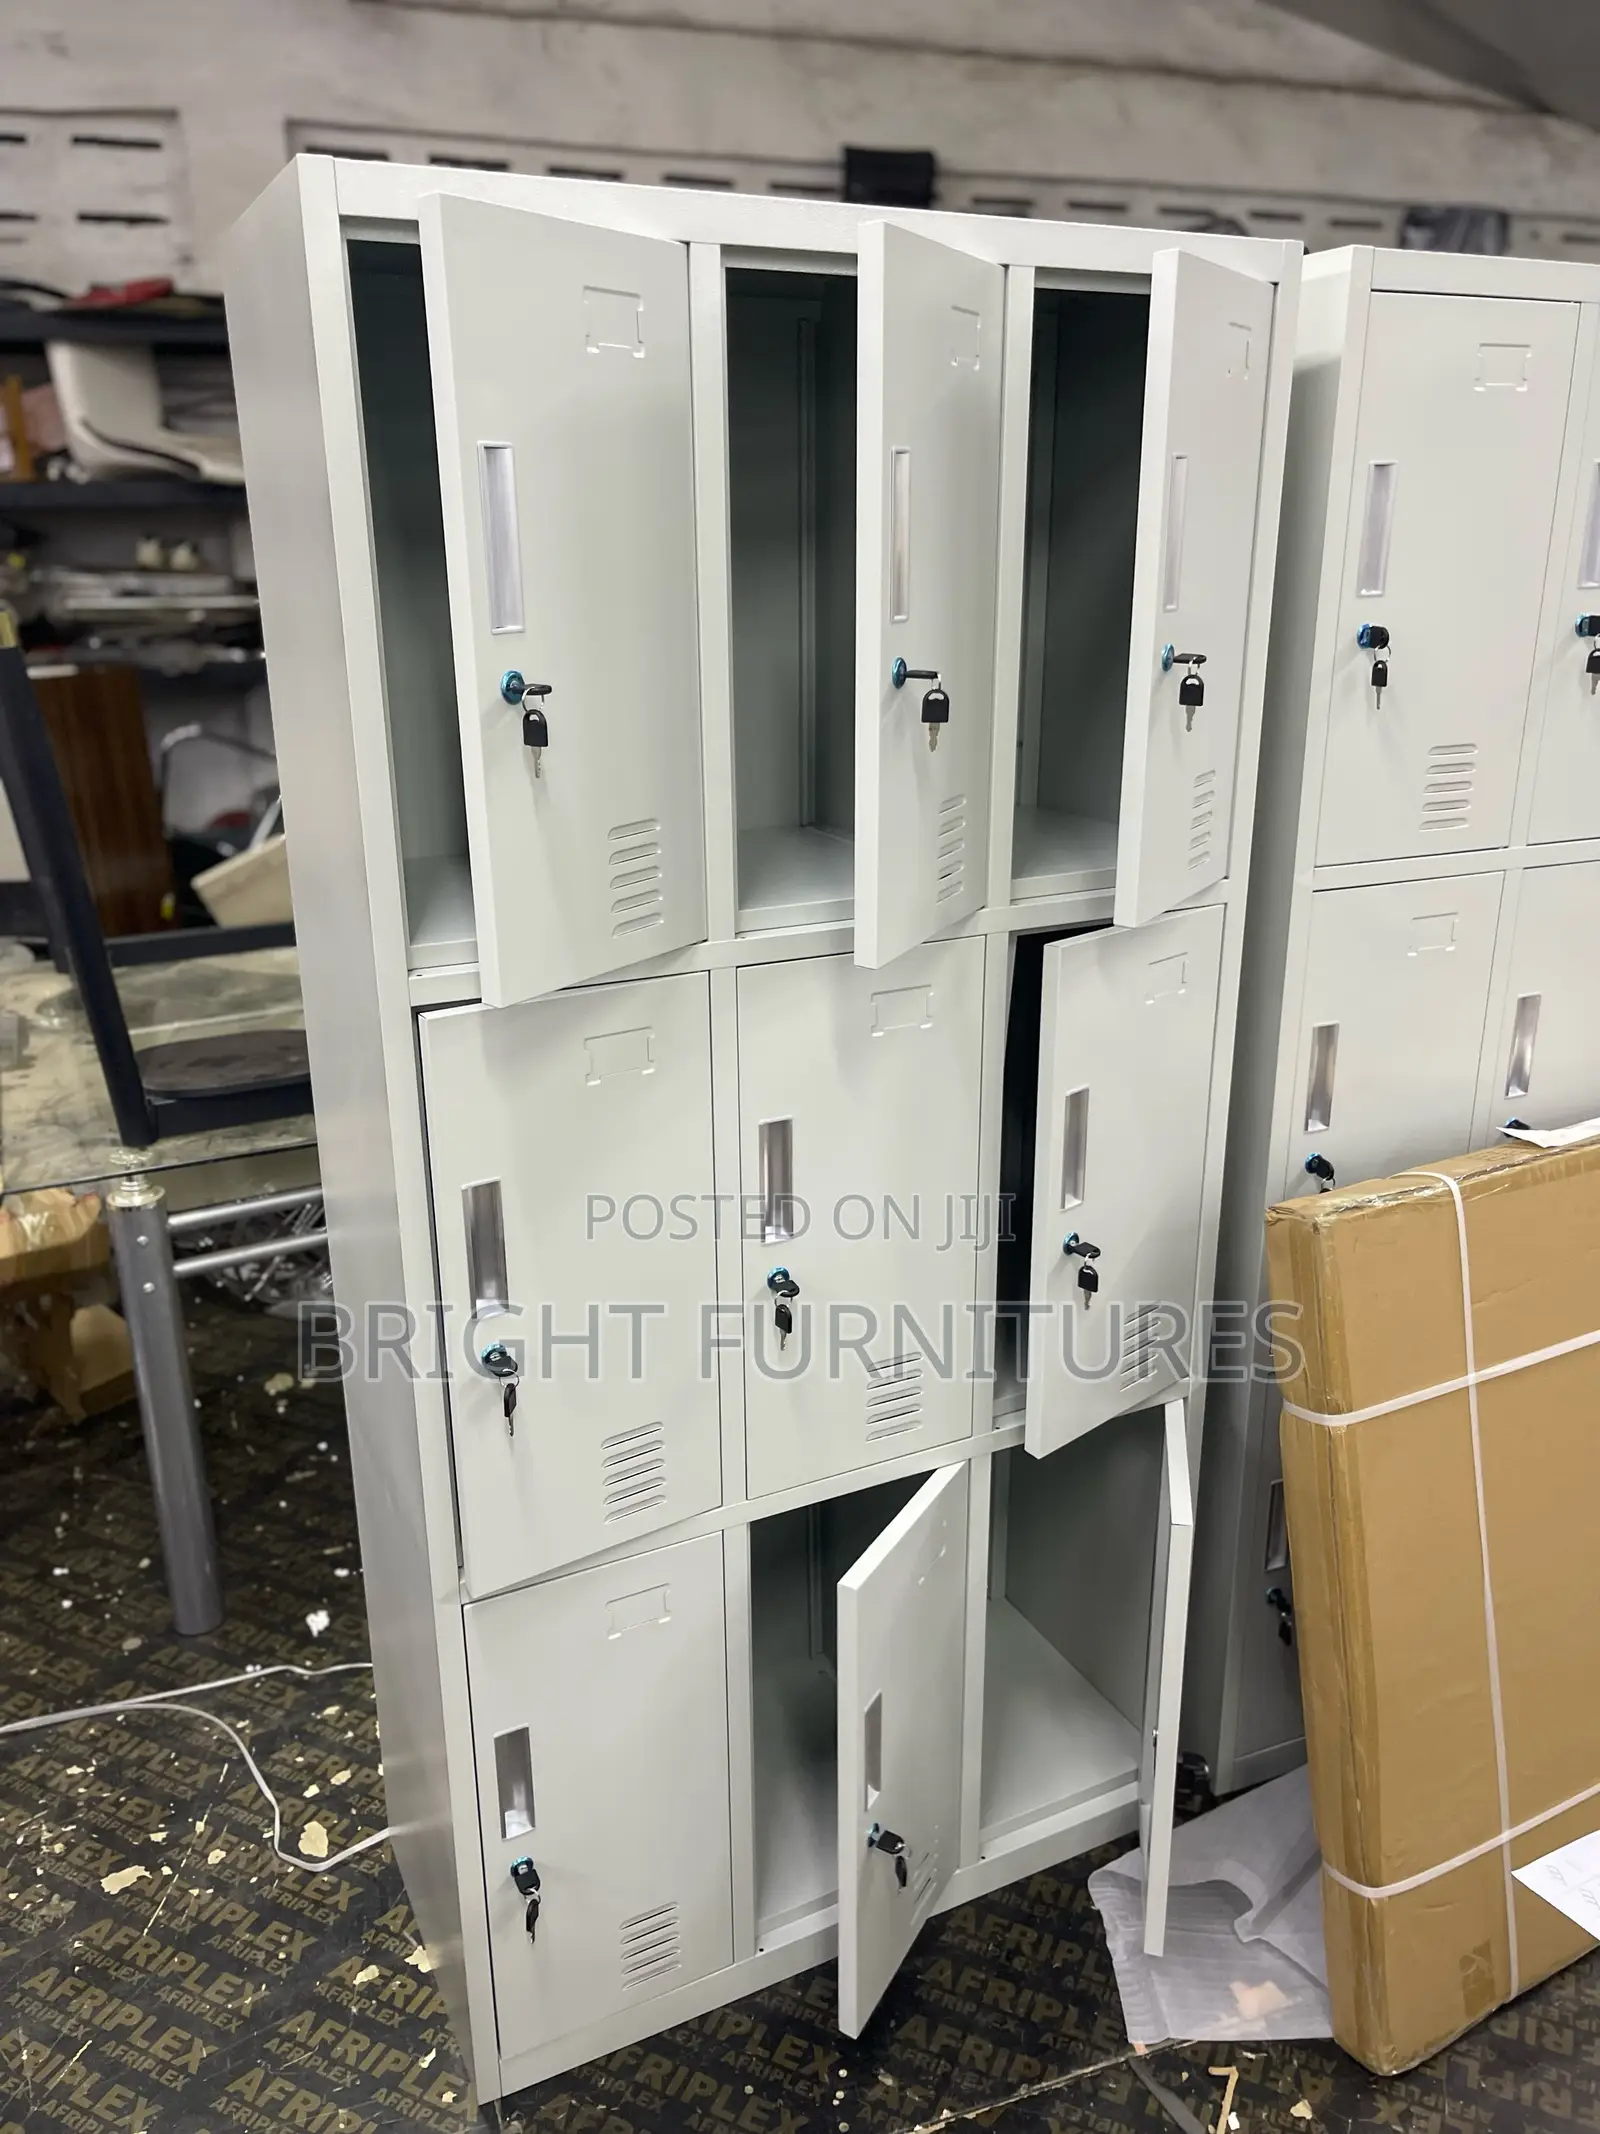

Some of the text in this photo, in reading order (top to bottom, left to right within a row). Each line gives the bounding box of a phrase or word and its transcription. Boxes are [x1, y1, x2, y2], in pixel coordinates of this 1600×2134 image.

[219, 1617, 344, 1668] FRIPLEX
[269, 1743, 386, 1799] AFRIP
[224, 1783, 394, 1864] AFRIPLE
[257, 1883, 343, 1928] AFRIPLEX
[79, 1918, 271, 2019] AFRIPLEX
[360, 1928, 420, 1957] AFRIP
[944, 1904, 1109, 1984] AFRIPL
[20, 1966, 219, 2076] AFRIPLEX
[153, 1984, 244, 2035] AFRIPLEX
[327, 1956, 448, 2021] AFRIP
[757, 1991, 839, 2036] AFRIPLE
[916, 1959, 1123, 2056] AFRIPLE
[98, 2040, 190, 2093] AFRIPLEX
[688, 2008, 843, 2086] IPLEX
[893, 2014, 1058, 2084] AFRIP
[0, 2028, 164, 2134] FRIPLEX
[223, 2067, 378, 2134] AFRIP
[596, 2044, 807, 2134] FRIPLEX
[1384, 2079, 1496, 2125] AFRIPLE
[40, 2100, 108, 2134] AFRIP
[208, 2096, 292, 2134] AFRIP
